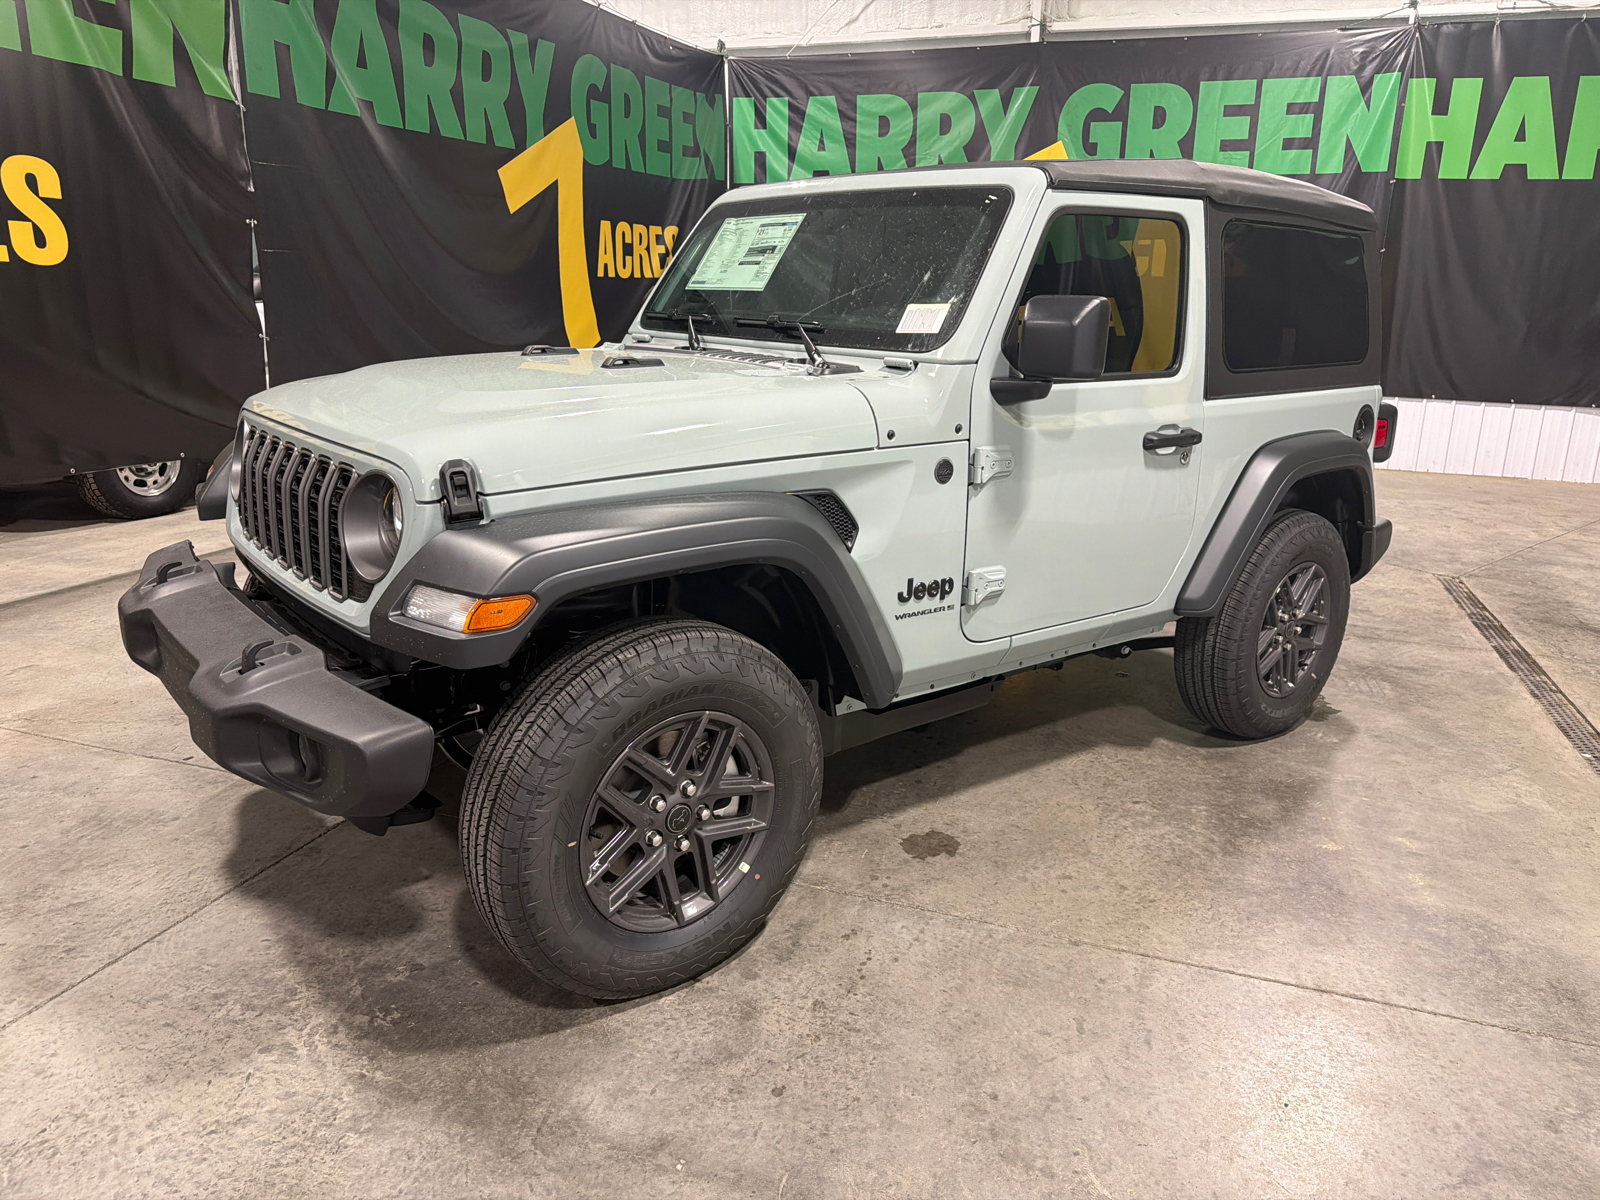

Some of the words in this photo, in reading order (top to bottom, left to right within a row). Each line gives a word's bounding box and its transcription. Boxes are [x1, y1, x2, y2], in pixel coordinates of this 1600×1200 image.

[238, 0, 556, 150] HARRY
[570, 53, 726, 181] GREEN
[732, 86, 1040, 184] HARRY
[1057, 72, 1402, 175] GREEN
[497, 115, 602, 349] 7
[894, 605, 947, 621] WRANGLER
[897, 576, 954, 604] Jeep
